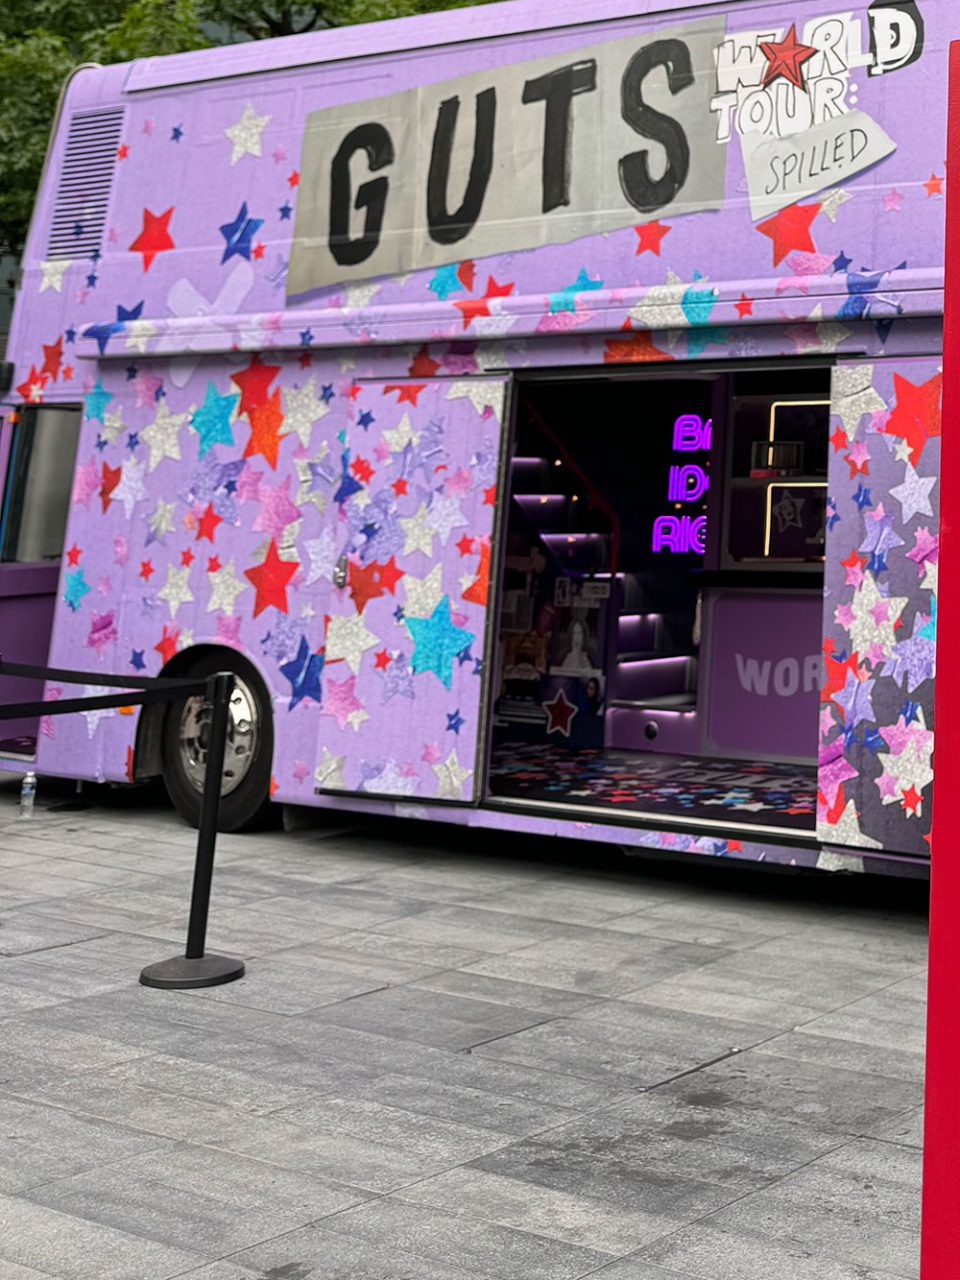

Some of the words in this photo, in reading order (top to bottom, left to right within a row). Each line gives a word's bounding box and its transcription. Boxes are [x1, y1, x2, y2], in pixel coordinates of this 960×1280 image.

[714, 0, 922, 93] WRLD
[327, 37, 696, 267] GUTS
[764, 128, 869, 195] SPILLED
